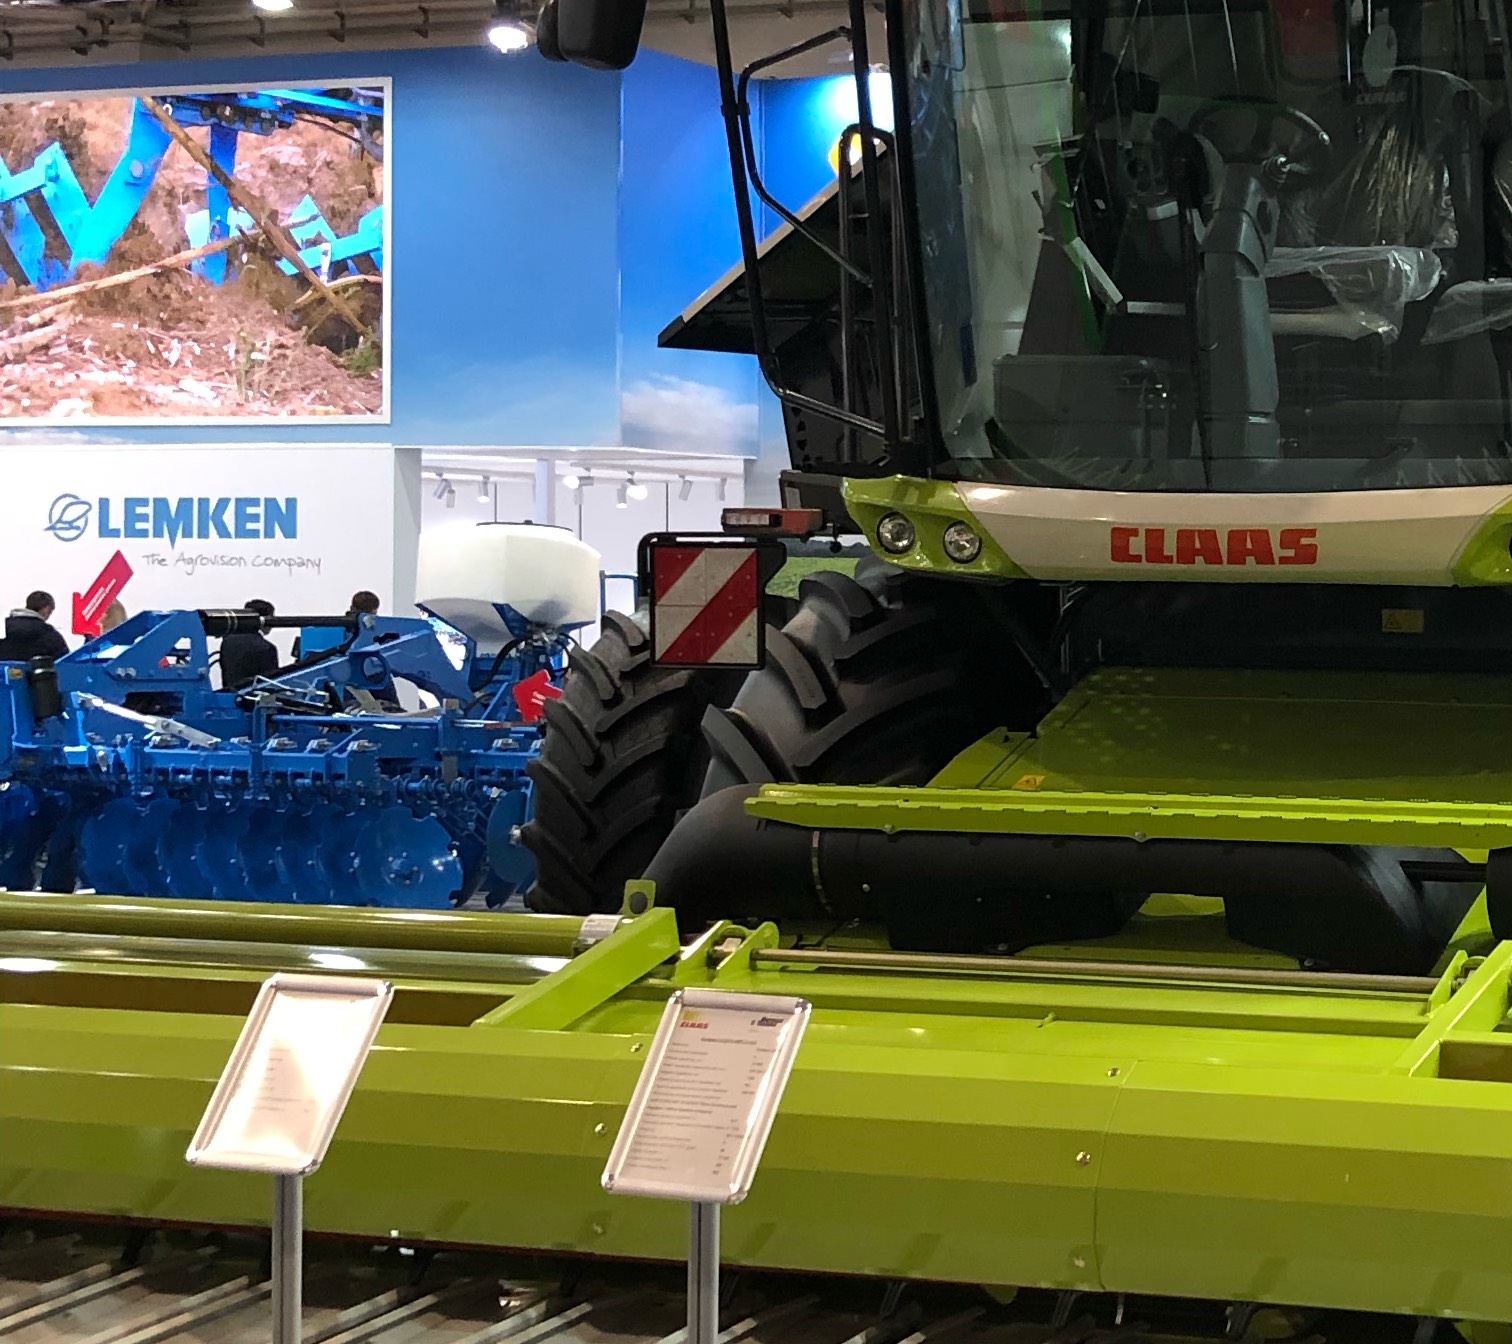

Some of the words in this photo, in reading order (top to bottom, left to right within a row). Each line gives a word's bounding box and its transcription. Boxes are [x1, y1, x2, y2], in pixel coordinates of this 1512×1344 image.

[98, 497, 298, 549] LEMKEN
[142, 553, 168, 567] The
[174, 552, 247, 576] Agrovision
[1110, 526, 1319, 566] CLAAS
